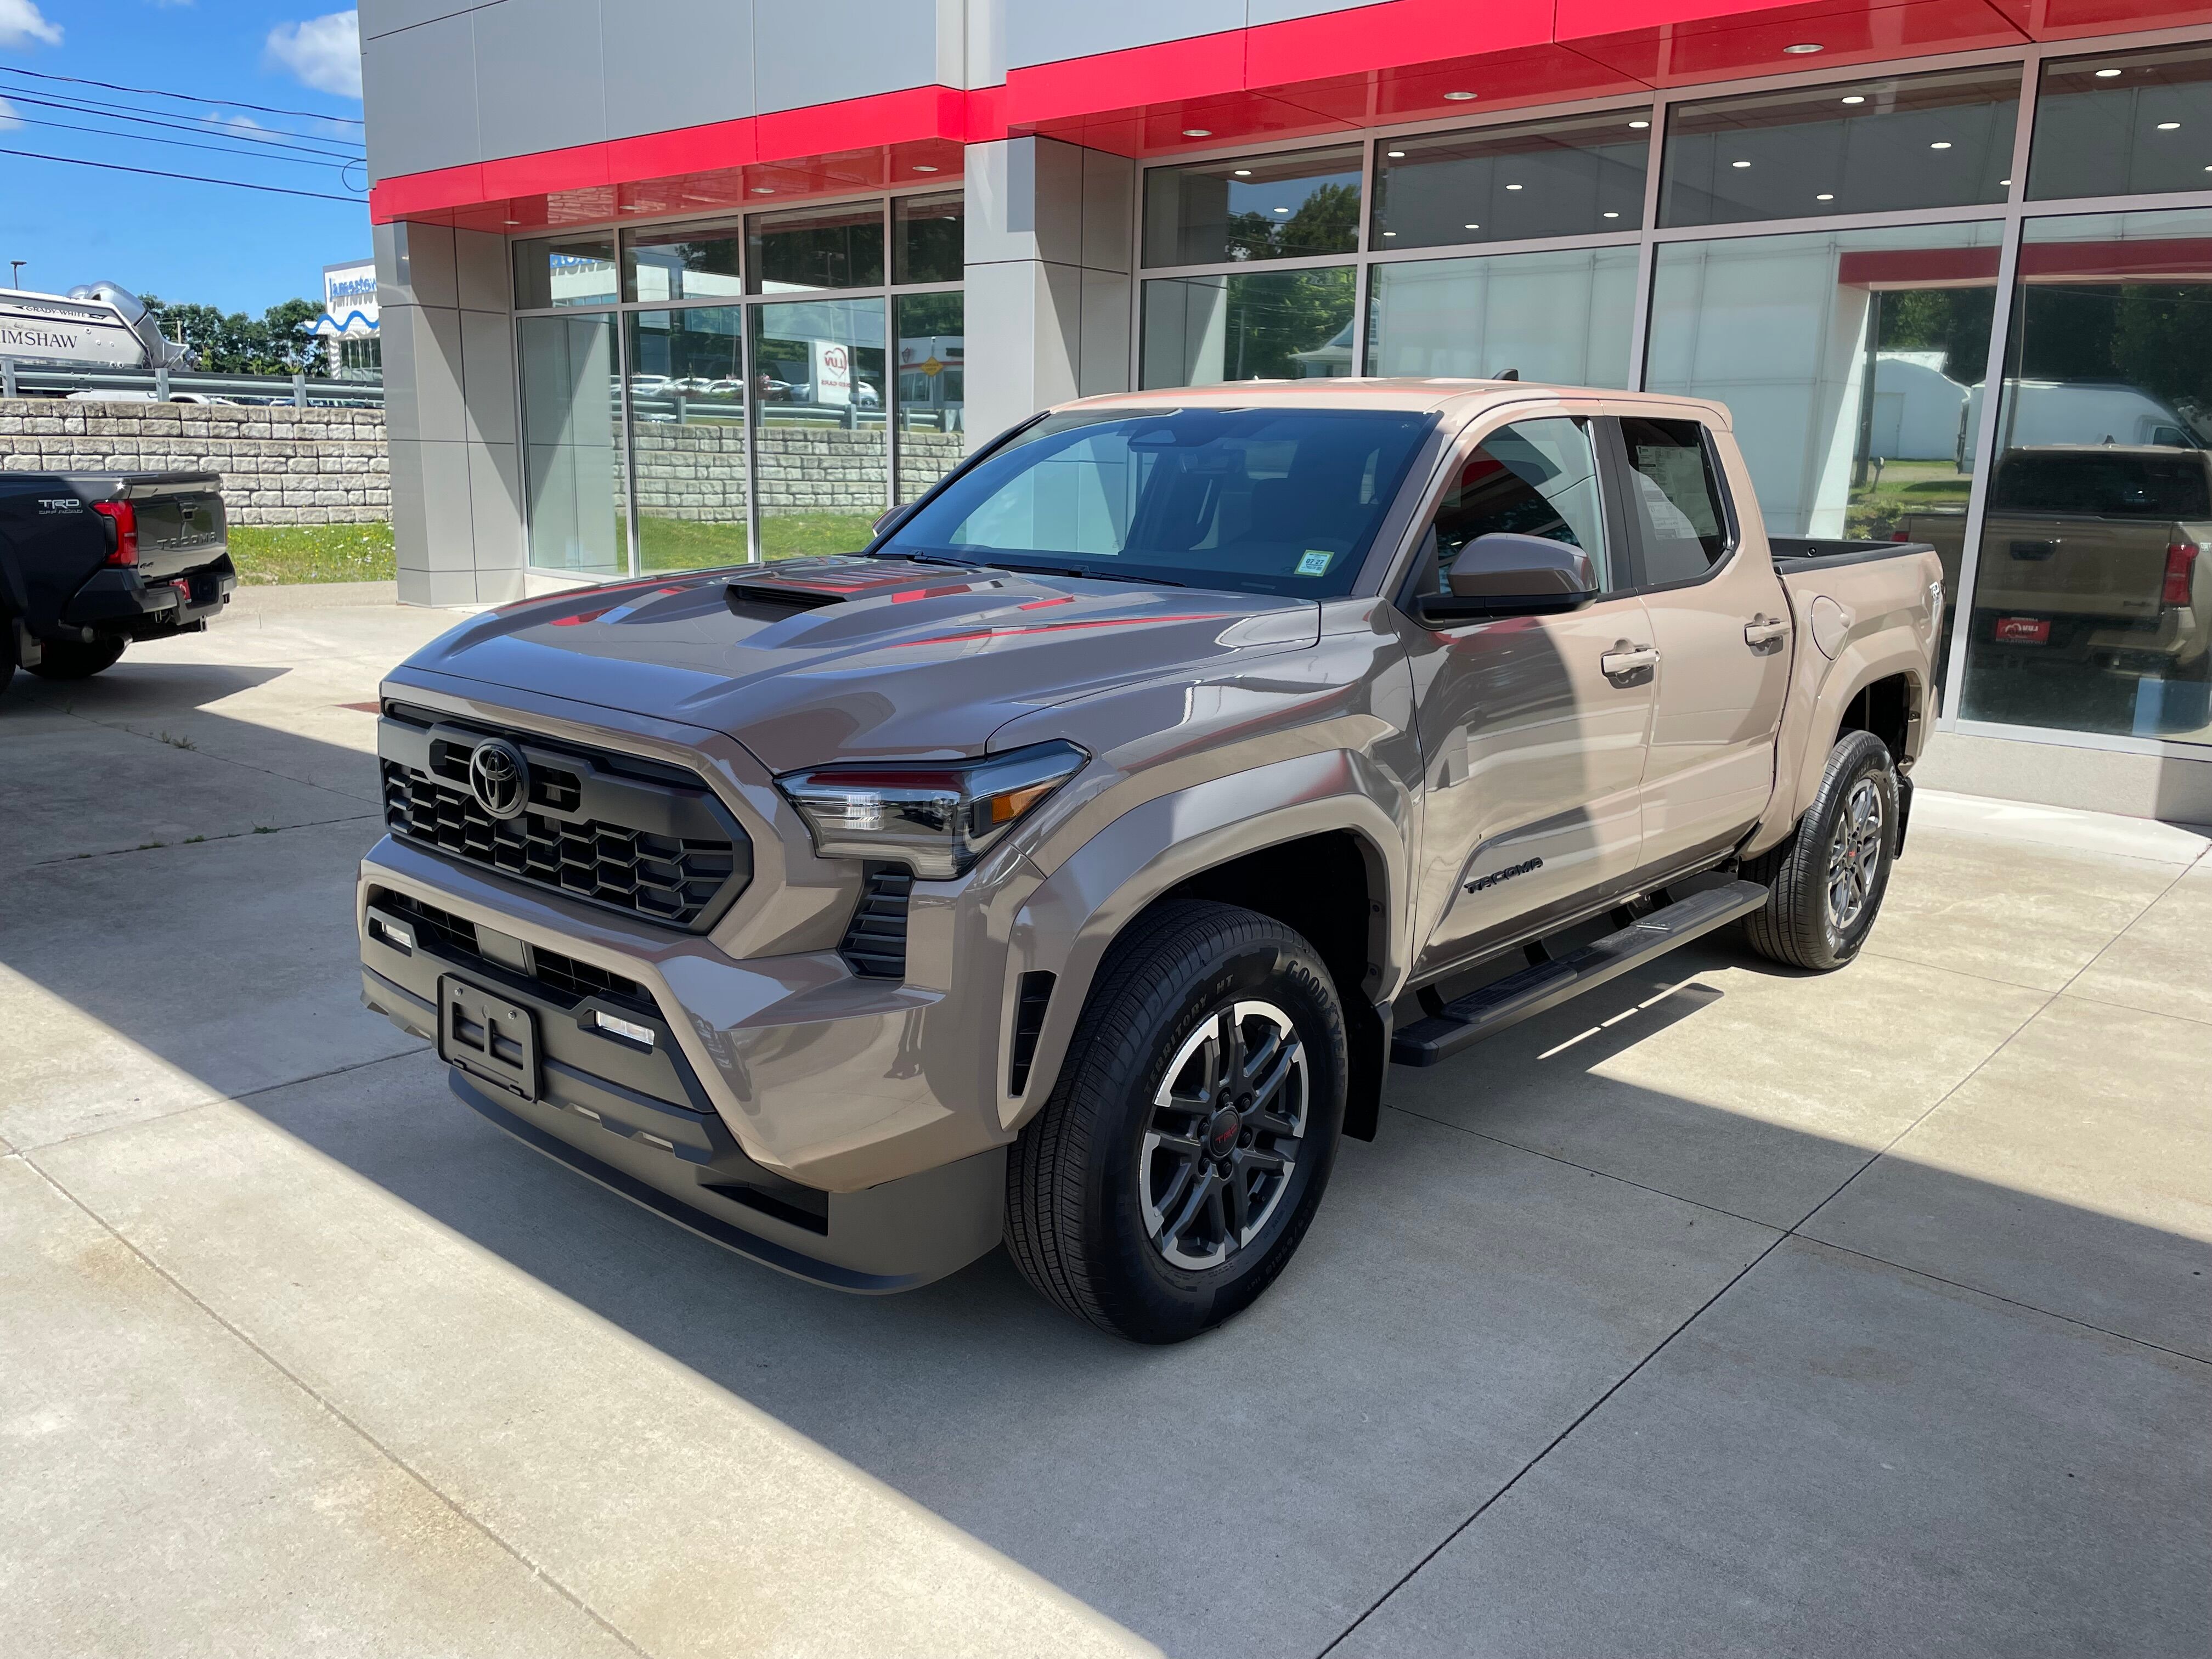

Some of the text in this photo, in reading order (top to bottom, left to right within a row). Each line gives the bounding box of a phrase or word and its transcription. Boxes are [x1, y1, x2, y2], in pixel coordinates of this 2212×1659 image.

[26, 305, 87, 318] GRADY-WHITE
[0, 329, 77, 349] IMSHAW
[38, 499, 80, 509] TRD
[156, 532, 217, 550] TACOMA
[1463, 857, 1544, 894] TACOMA
[1144, 974, 1234, 1094] TERRITORY HT
[1215, 1123, 1238, 1144] TRD
